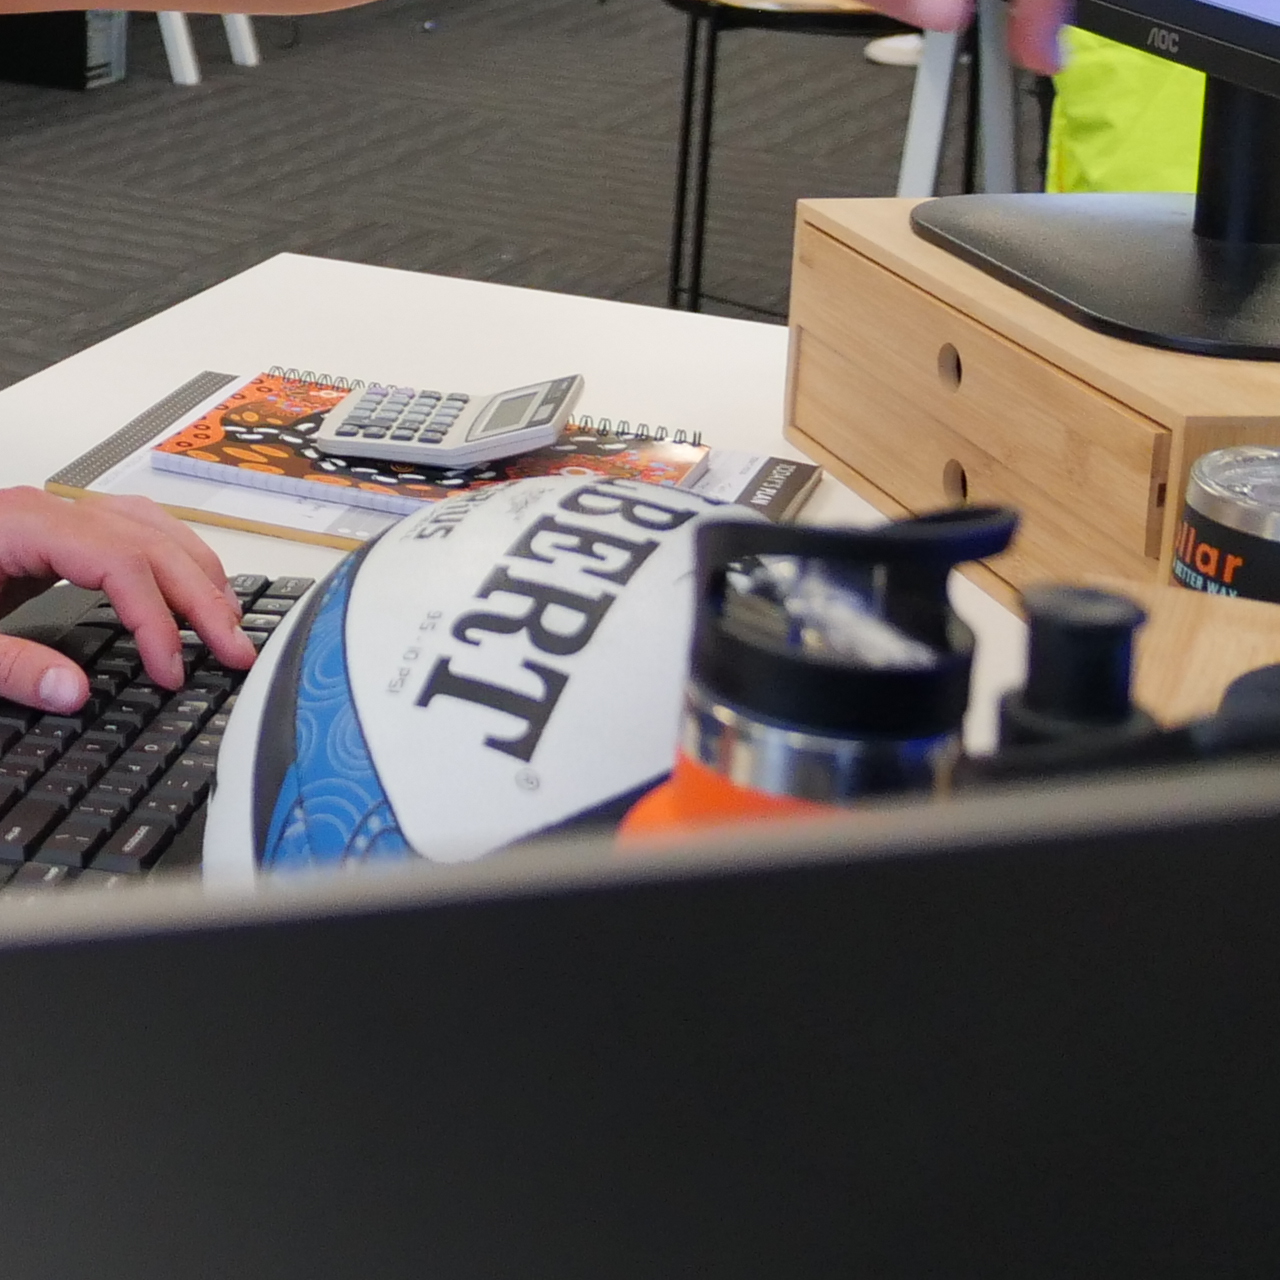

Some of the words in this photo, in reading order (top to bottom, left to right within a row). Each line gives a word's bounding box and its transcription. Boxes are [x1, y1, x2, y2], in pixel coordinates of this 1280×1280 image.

[1147, 26, 1180, 54] AOC
[749, 486, 778, 506] PLAN
[1206, 579, 1238, 599] WAY
[413, 478, 699, 763] BERT
